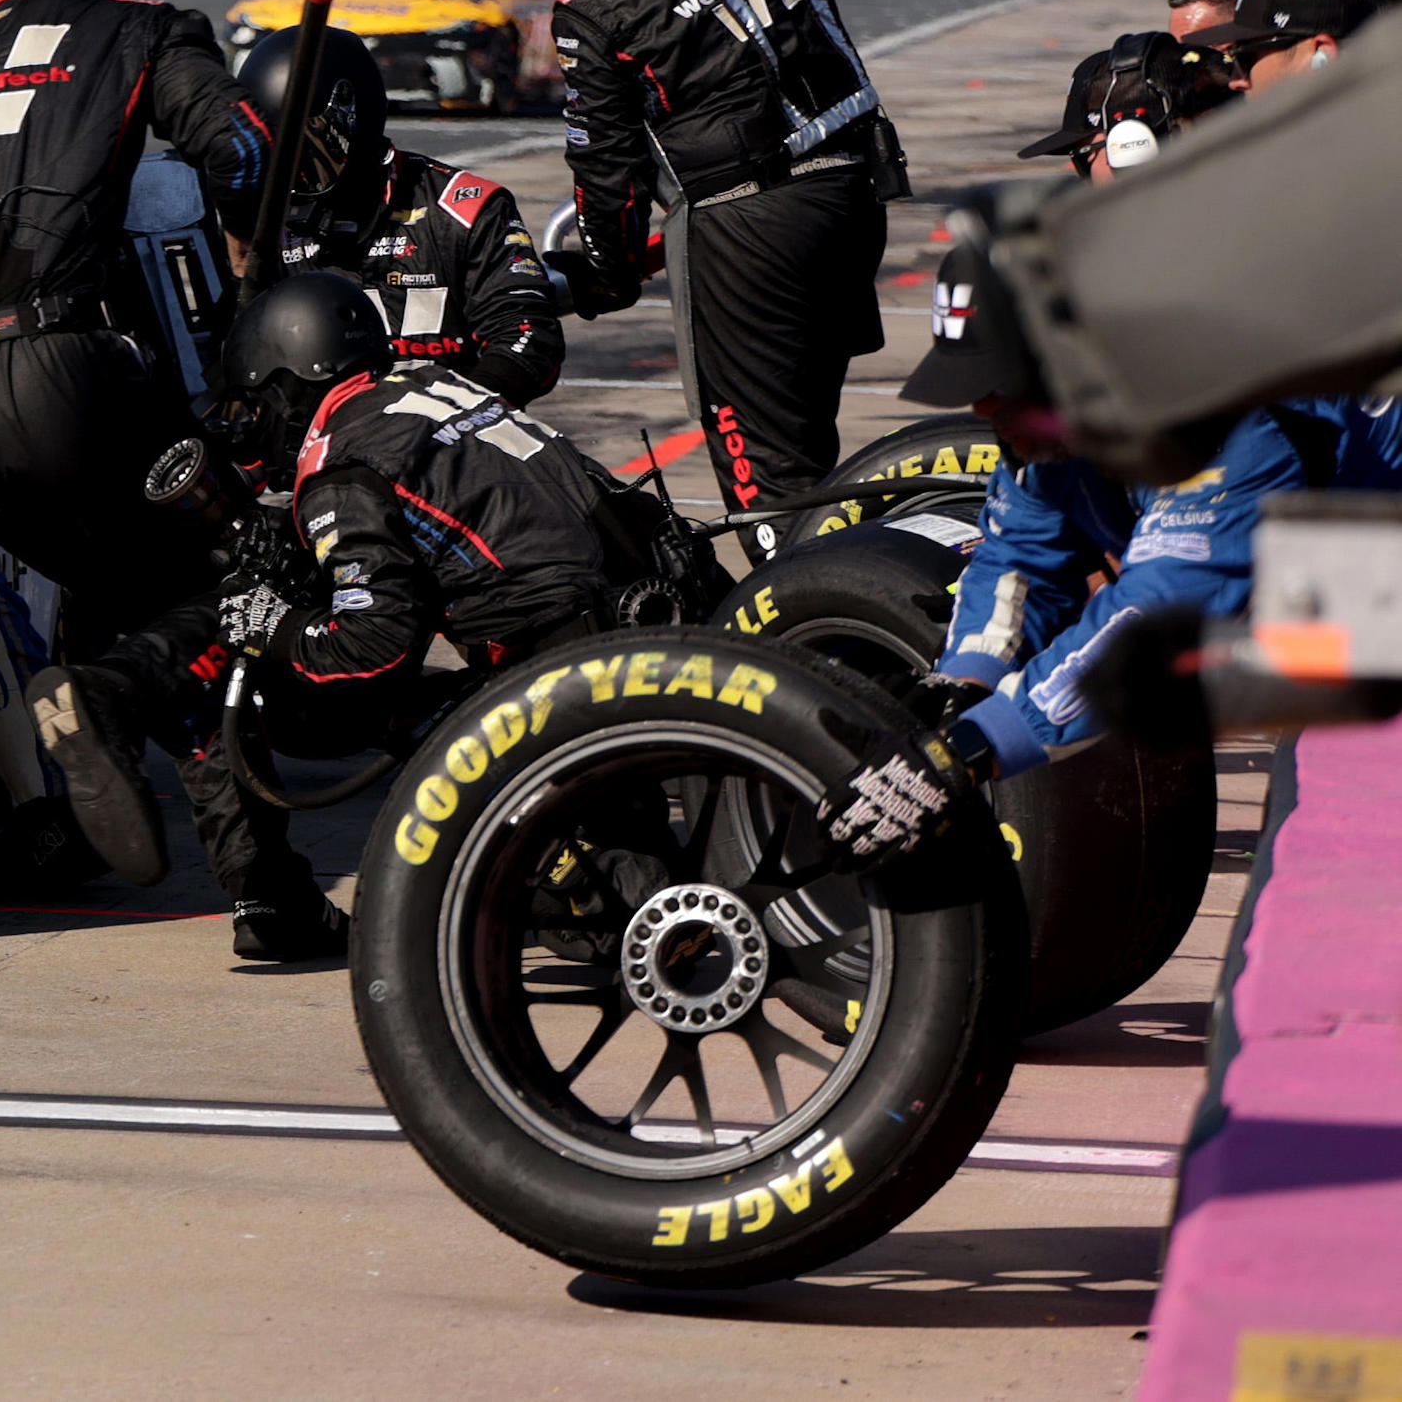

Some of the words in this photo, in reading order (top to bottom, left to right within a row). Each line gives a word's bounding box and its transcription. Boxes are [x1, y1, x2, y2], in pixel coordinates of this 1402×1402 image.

[308, 511, 335, 533] SCAR
[1160, 509, 1216, 529] CELSIUS
[395, 651, 778, 866] GOODYEAR
[652, 1136, 855, 1246] EAGLE
